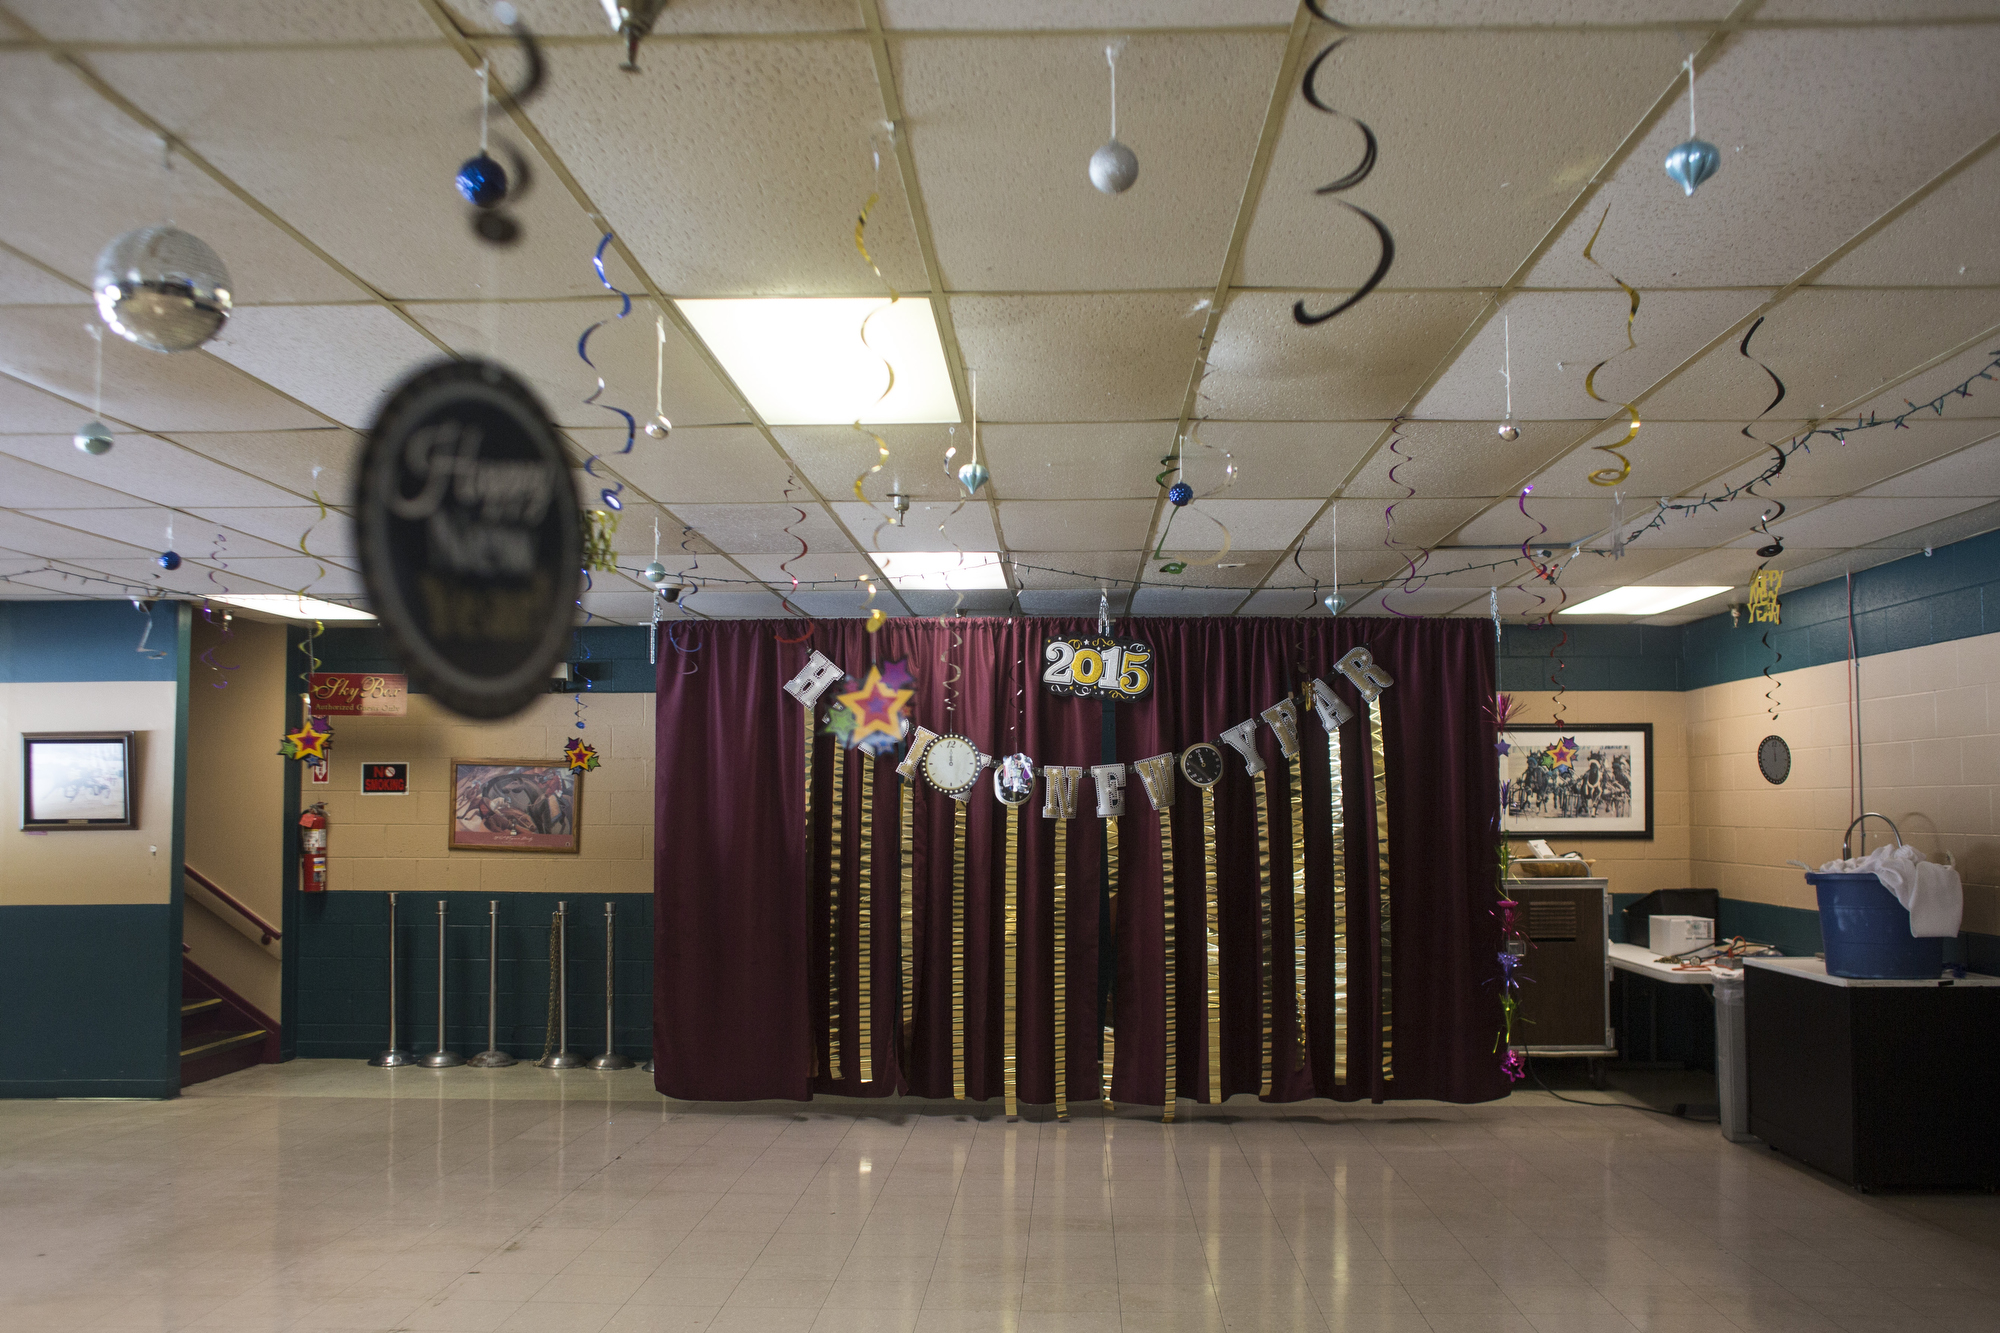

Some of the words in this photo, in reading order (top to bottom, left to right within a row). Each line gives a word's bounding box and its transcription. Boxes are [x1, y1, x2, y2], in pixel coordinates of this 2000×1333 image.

[1043, 642, 1150, 693] 2015
[315, 676, 360, 704] Sky
[945, 740, 957, 749] 12
[373, 766, 396, 778] NO
[365, 779, 404, 791] SMOKING
[1043, 752, 1175, 818] NEW
